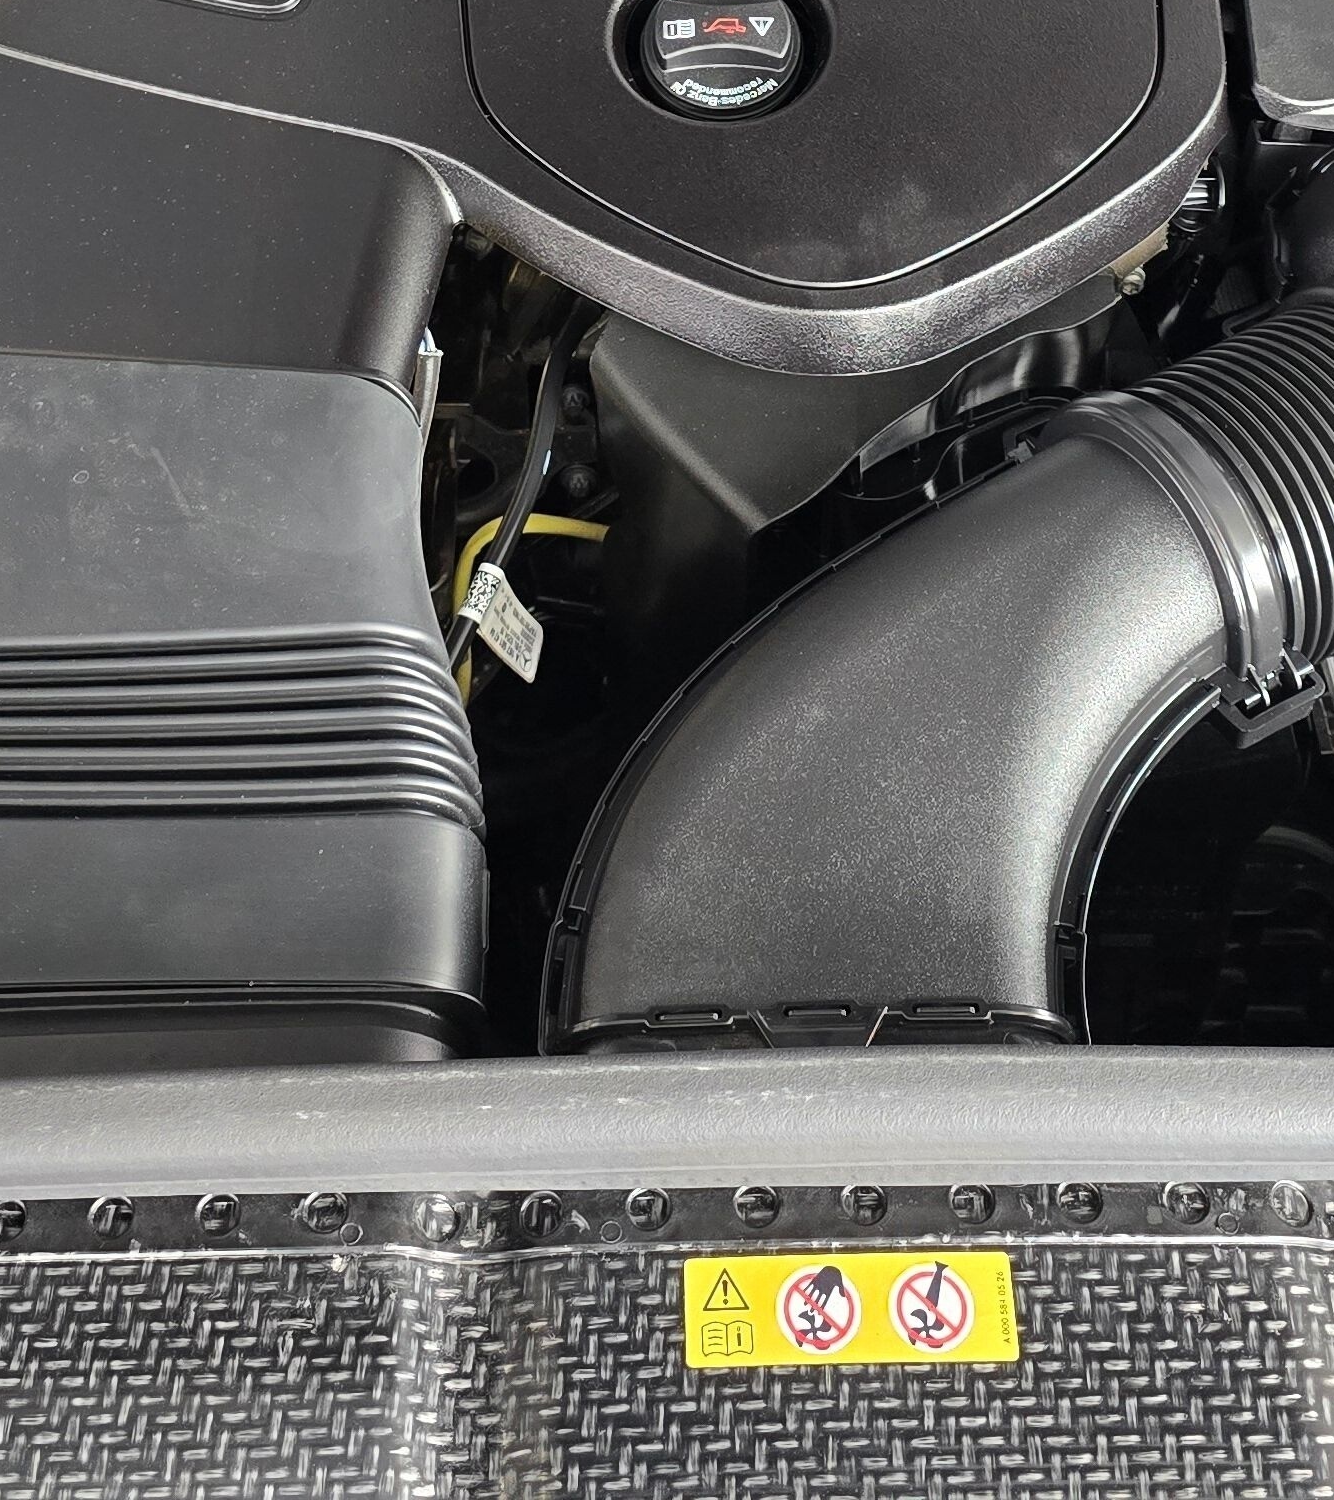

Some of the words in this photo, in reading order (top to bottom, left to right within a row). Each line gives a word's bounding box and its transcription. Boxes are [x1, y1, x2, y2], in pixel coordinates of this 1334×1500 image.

[683, 76, 764, 96] recommended
[995, 1270, 1005, 1282] 26
[997, 1284, 1006, 1296] 05
[1001, 1317, 1011, 1336] 000
[1003, 1337, 1012, 1345] A
